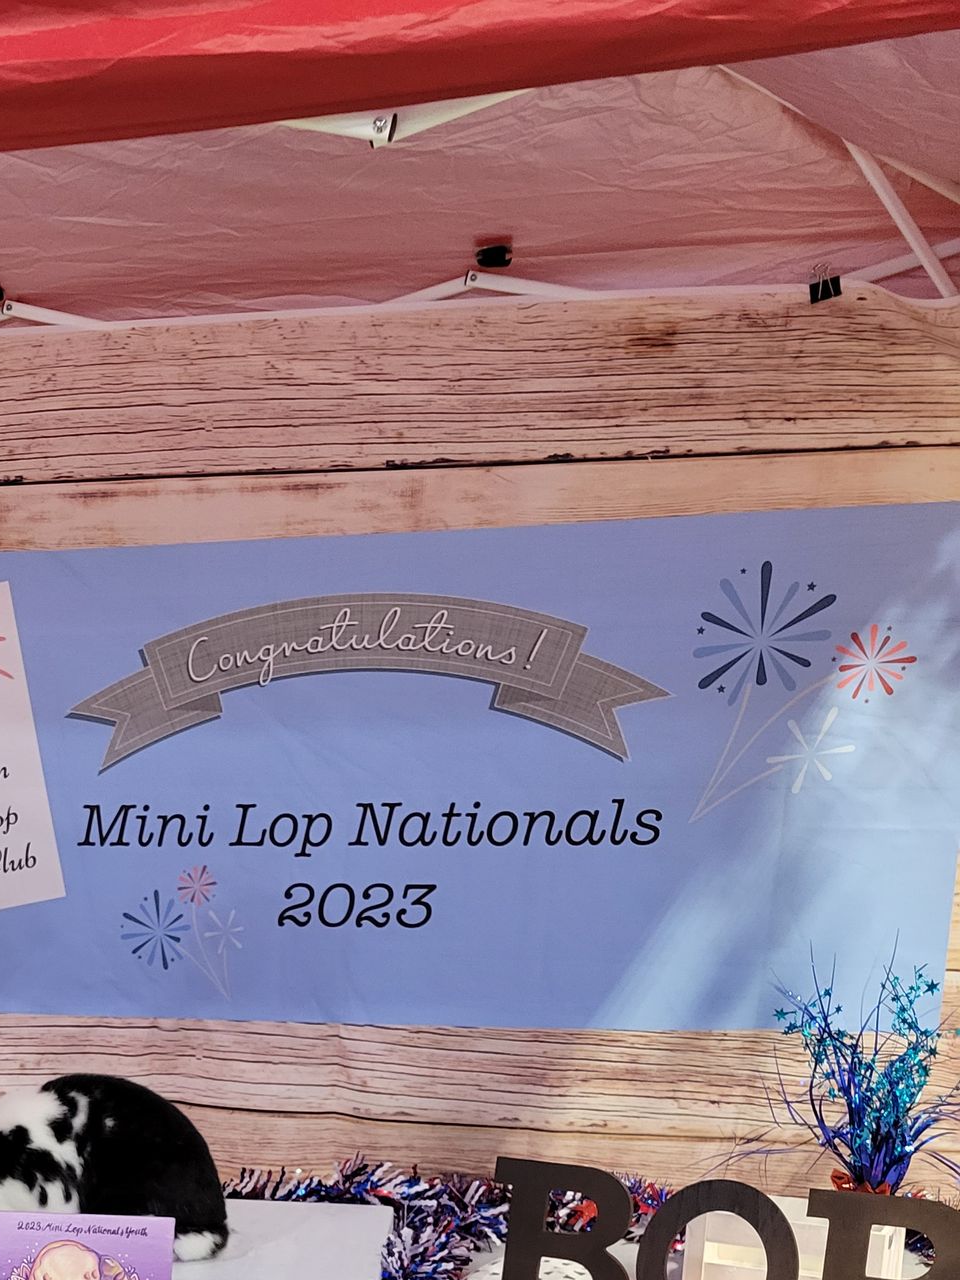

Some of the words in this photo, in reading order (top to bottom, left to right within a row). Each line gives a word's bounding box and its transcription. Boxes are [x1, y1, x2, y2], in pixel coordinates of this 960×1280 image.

[185, 606, 549, 687] Congratulations!
[76, 802, 215, 848] Mini
[228, 803, 334, 858] Lop
[347, 798, 663, 848] Nationals
[276, 882, 438, 929] 2023
[17, 1220, 42, 1231] 2023
